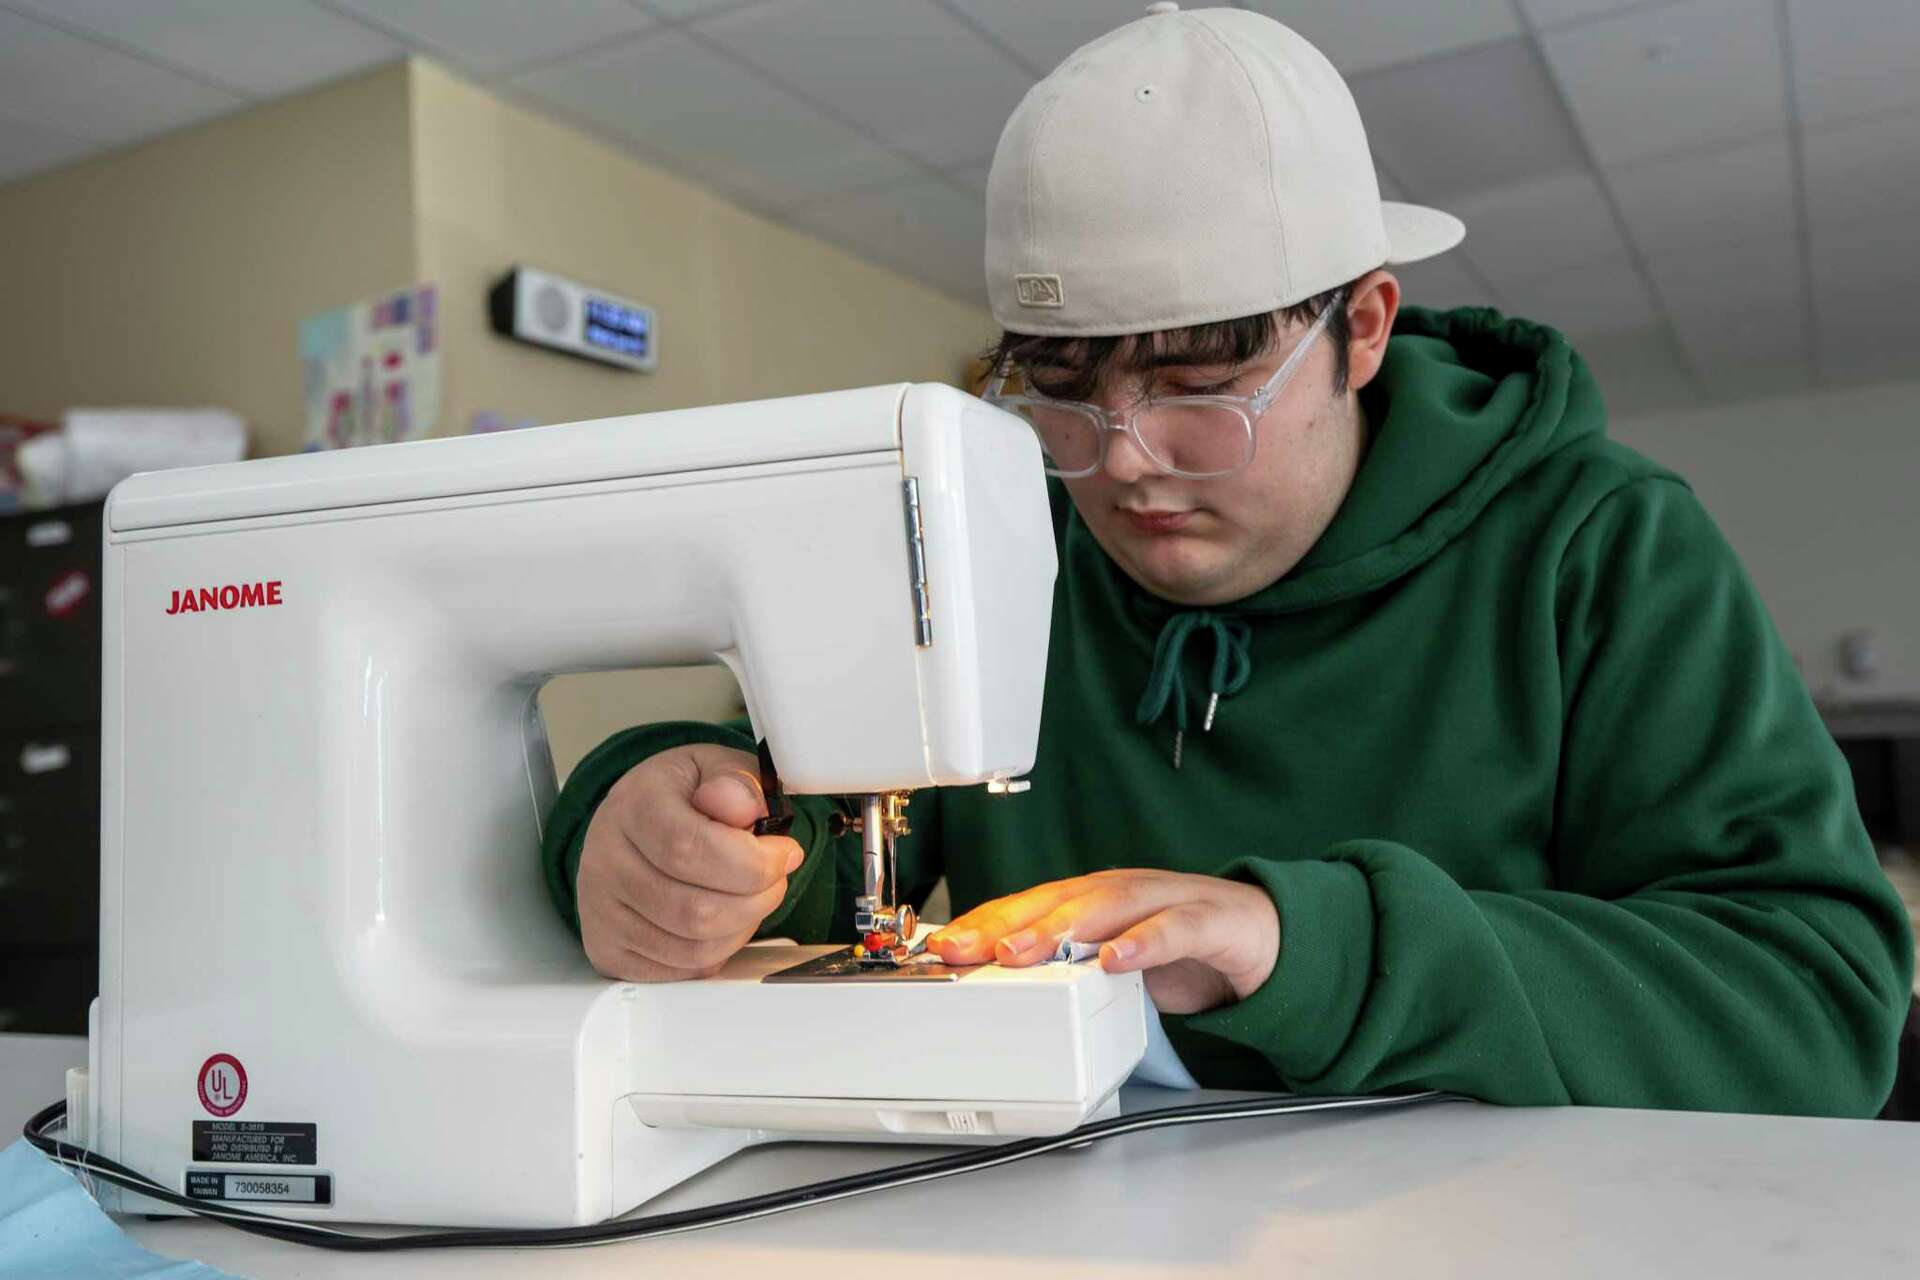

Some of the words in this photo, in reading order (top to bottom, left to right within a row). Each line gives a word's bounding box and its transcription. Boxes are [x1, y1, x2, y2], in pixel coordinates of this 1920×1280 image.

[165, 580, 283, 615] JANOME
[211, 1068, 234, 1100] UL
[211, 1135, 267, 1144] MANUFACTURED
[270, 1136, 285, 1144] FOR
[211, 1143, 228, 1152] AND
[230, 1144, 271, 1153] DISTRIBUTED
[211, 1152, 242, 1161] JANOME
[233, 1181, 290, 1195] 730058354
